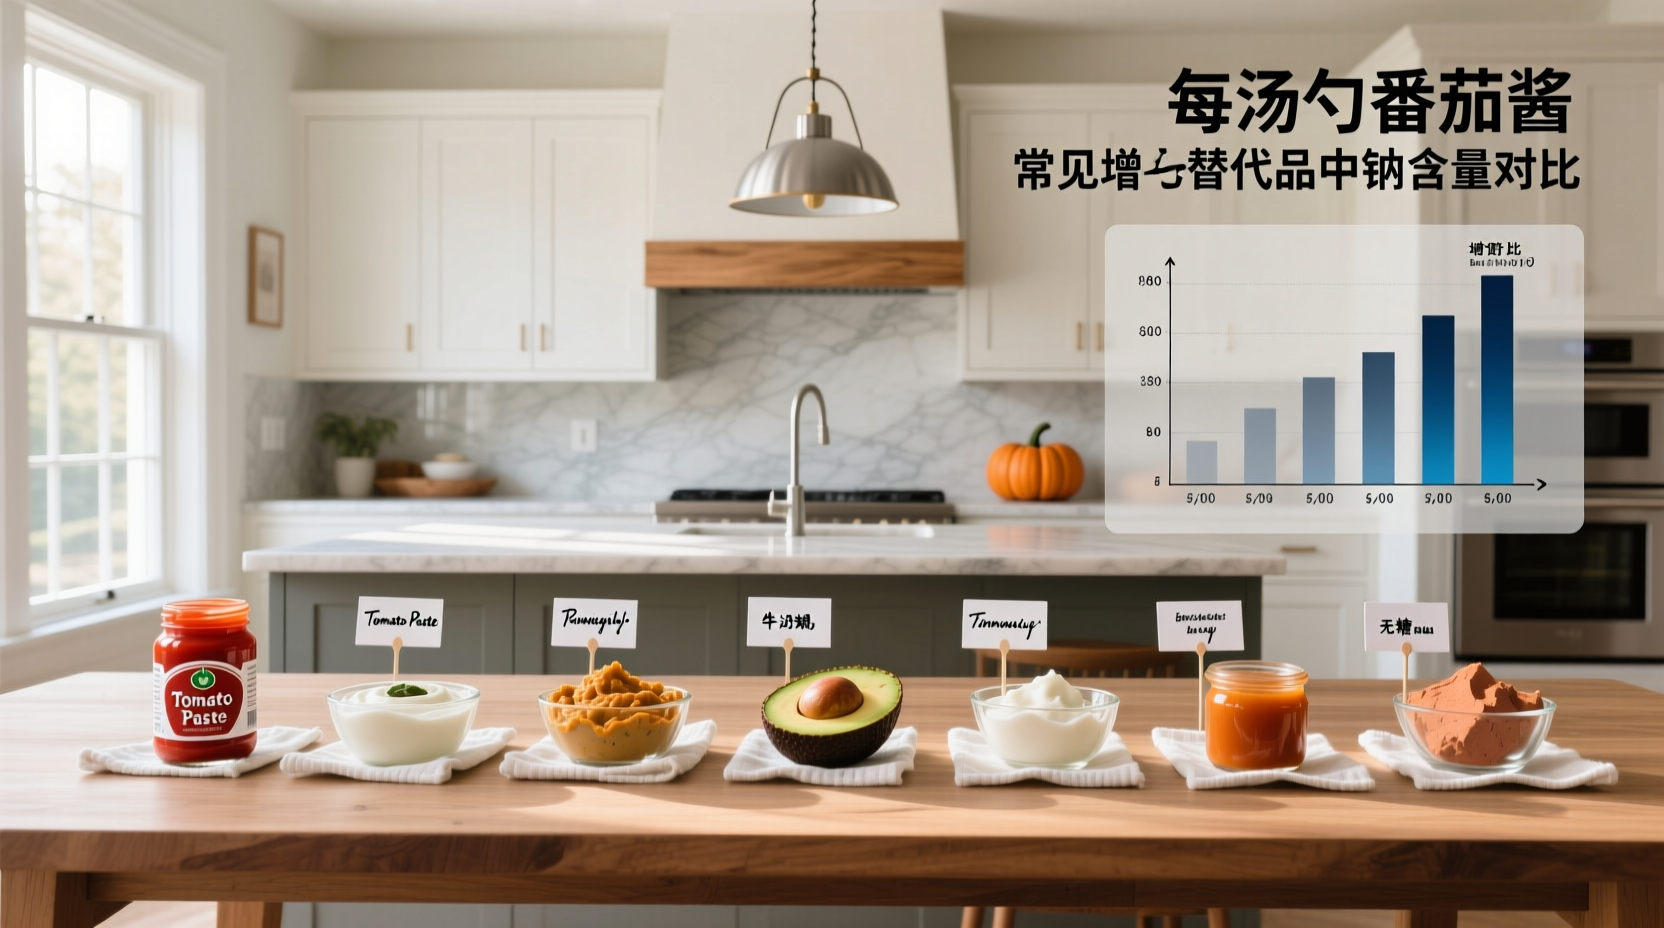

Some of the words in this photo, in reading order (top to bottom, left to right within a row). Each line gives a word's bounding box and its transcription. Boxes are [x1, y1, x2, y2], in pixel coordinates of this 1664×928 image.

[364, 610, 407, 627] Tomato
[409, 610, 438, 628] Paste
[171, 691, 233, 708] Tomato
[181, 709, 228, 726] Paste
